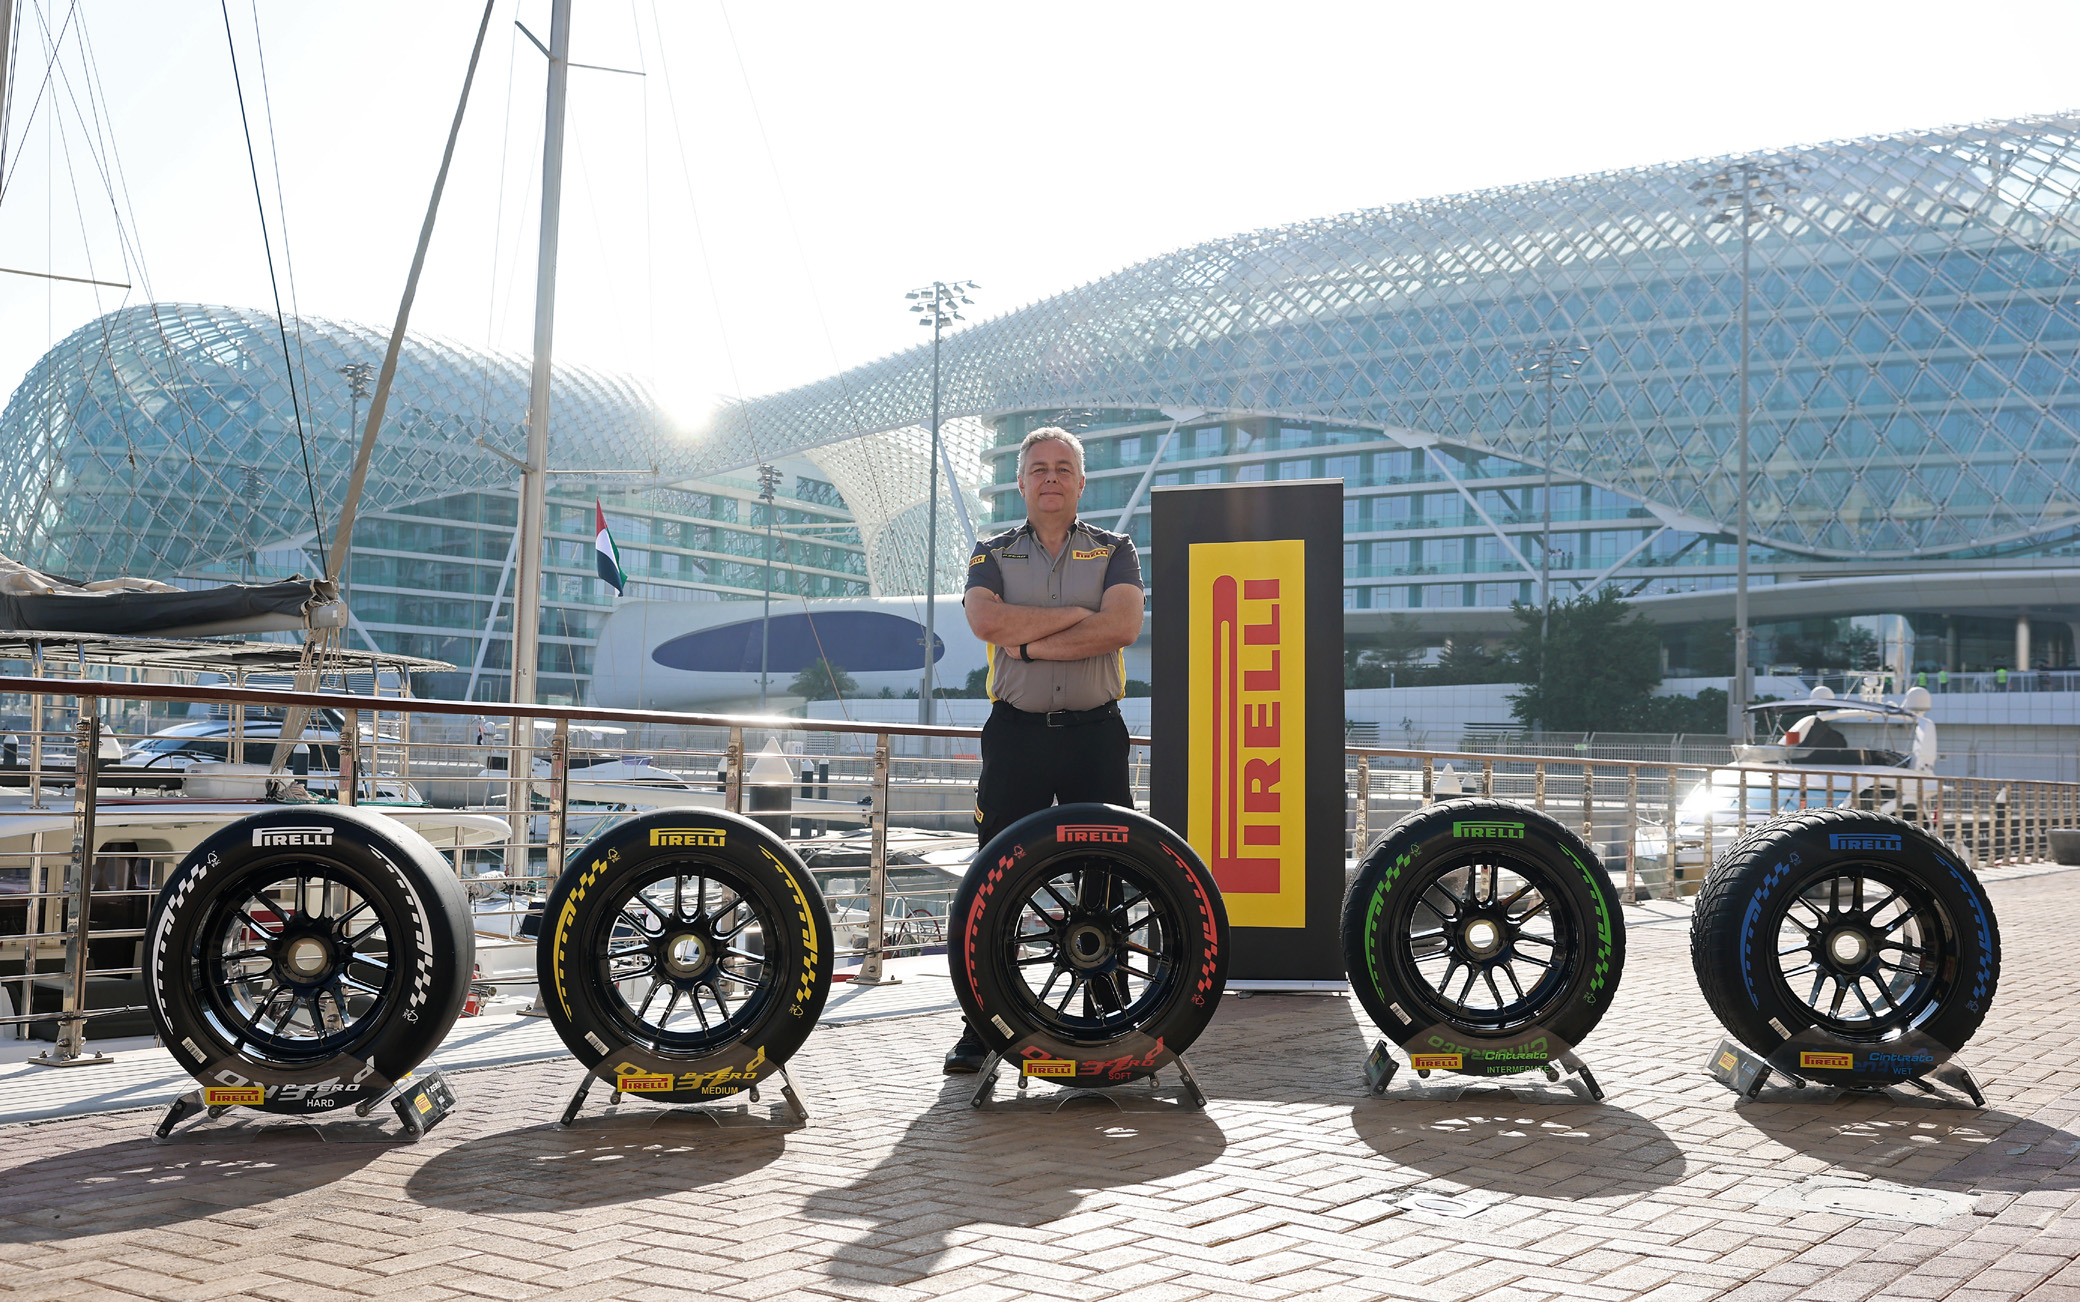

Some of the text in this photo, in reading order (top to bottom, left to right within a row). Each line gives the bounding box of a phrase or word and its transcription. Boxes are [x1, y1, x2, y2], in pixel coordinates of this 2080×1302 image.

[1211, 575, 1280, 893] PIRELLI
[1056, 824, 1130, 843] PIRELLI
[1452, 820, 1525, 839] PIRELLI
[252, 826, 335, 847] PIRELLI
[649, 827, 727, 847] PIRELLI
[1828, 833, 1902, 851] PIRELLI
[1484, 1050, 1549, 1061] Cinturato
[1804, 1054, 1849, 1066] PIRELLI
[1869, 1052, 1934, 1062] Cinturato
[1415, 1056, 1458, 1067] PIRELLI
[1027, 1063, 1072, 1074] PIRELLI
[1486, 1065, 1550, 1074] INTERMEDIATE
[1893, 1067, 1913, 1075] WET
[703, 1072, 758, 1080] ZERO
[1108, 1072, 1132, 1080] SOFT
[304, 1083, 361, 1092] ZERO
[621, 1077, 669, 1089] PIRELLI
[210, 1090, 259, 1102] PIRELLI
[701, 1086, 739, 1095] MEDIUM
[306, 1099, 335, 1108] HARD
